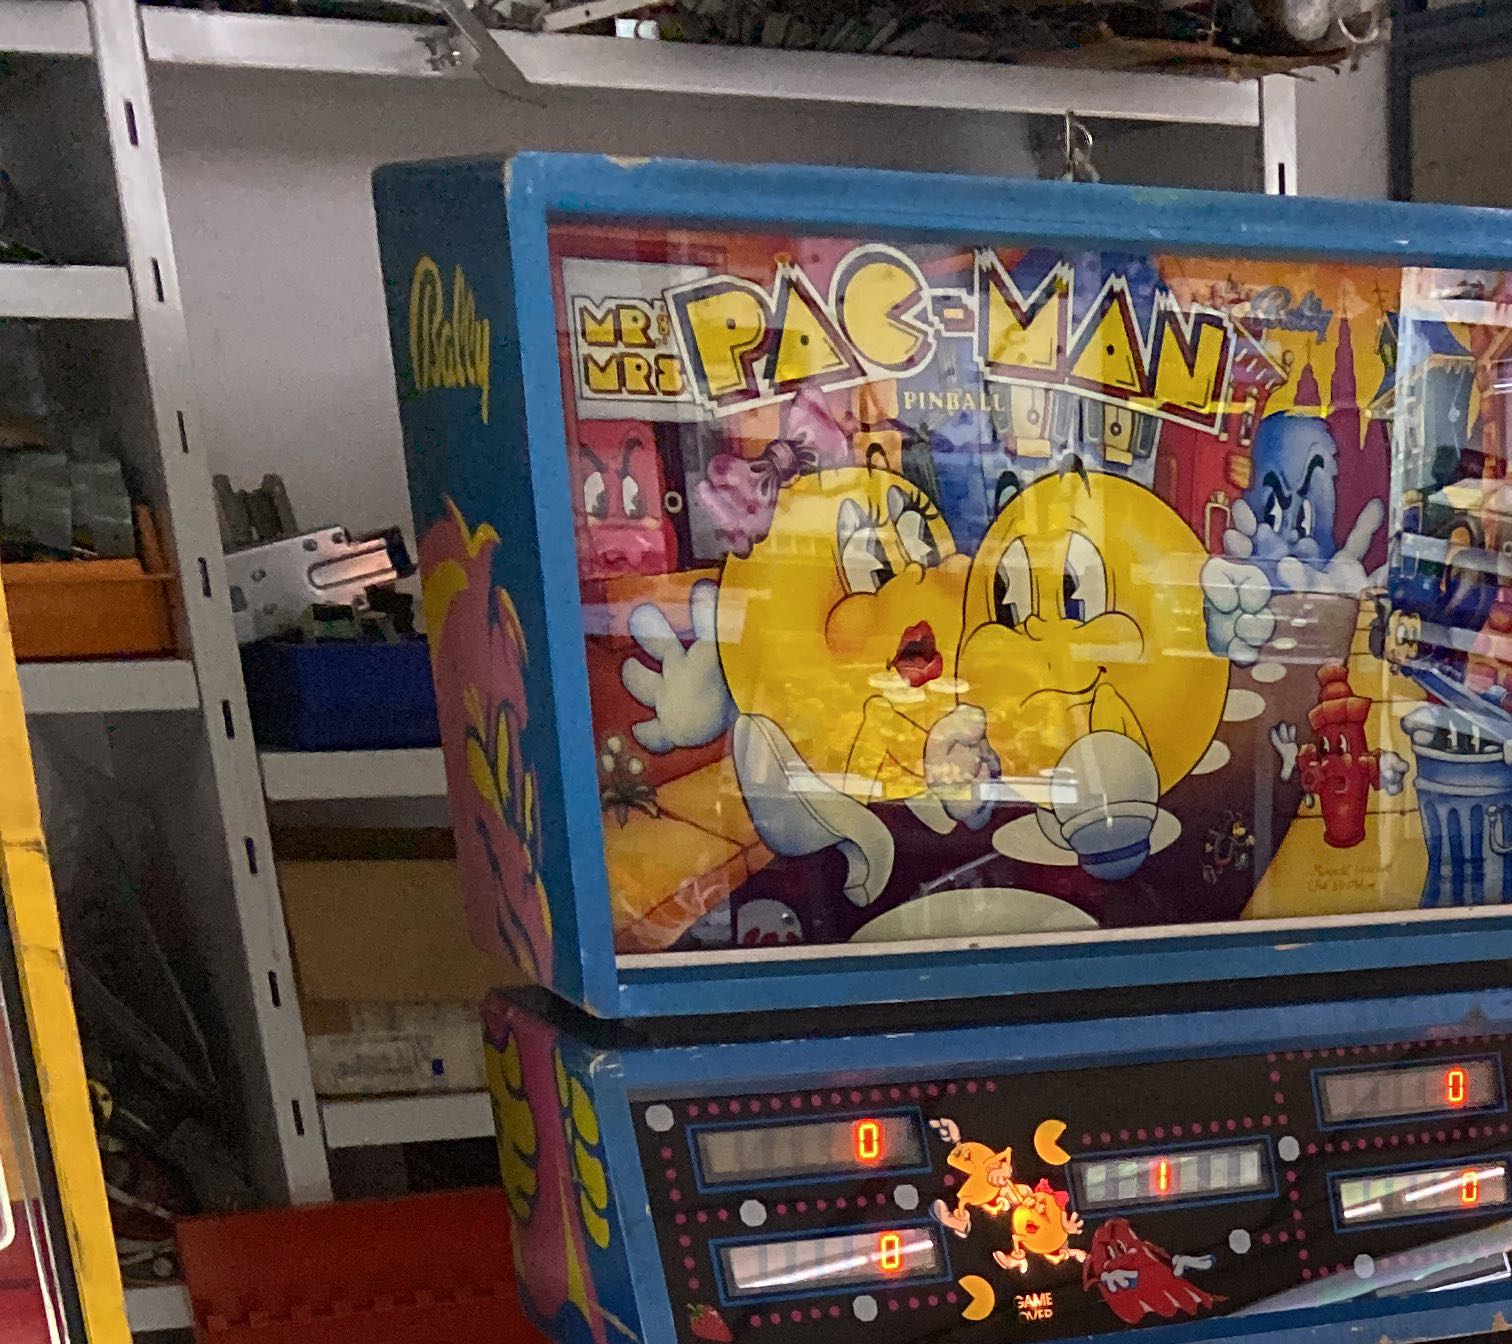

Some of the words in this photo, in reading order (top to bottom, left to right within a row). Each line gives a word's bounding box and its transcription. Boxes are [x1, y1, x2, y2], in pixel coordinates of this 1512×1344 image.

[409, 255, 490, 424] Bally
[662, 243, 1238, 437] PAC-MAN
[583, 352, 686, 396] MRS
[903, 390, 1006, 414] PINBALL
[1446, 1067, 1467, 1105] 0
[856, 1120, 881, 1159] 0
[1158, 1160, 1169, 1192] 1
[1462, 1169, 1480, 1204] 0
[879, 1232, 904, 1271] 0
[1014, 1292, 1054, 1309] GAME
